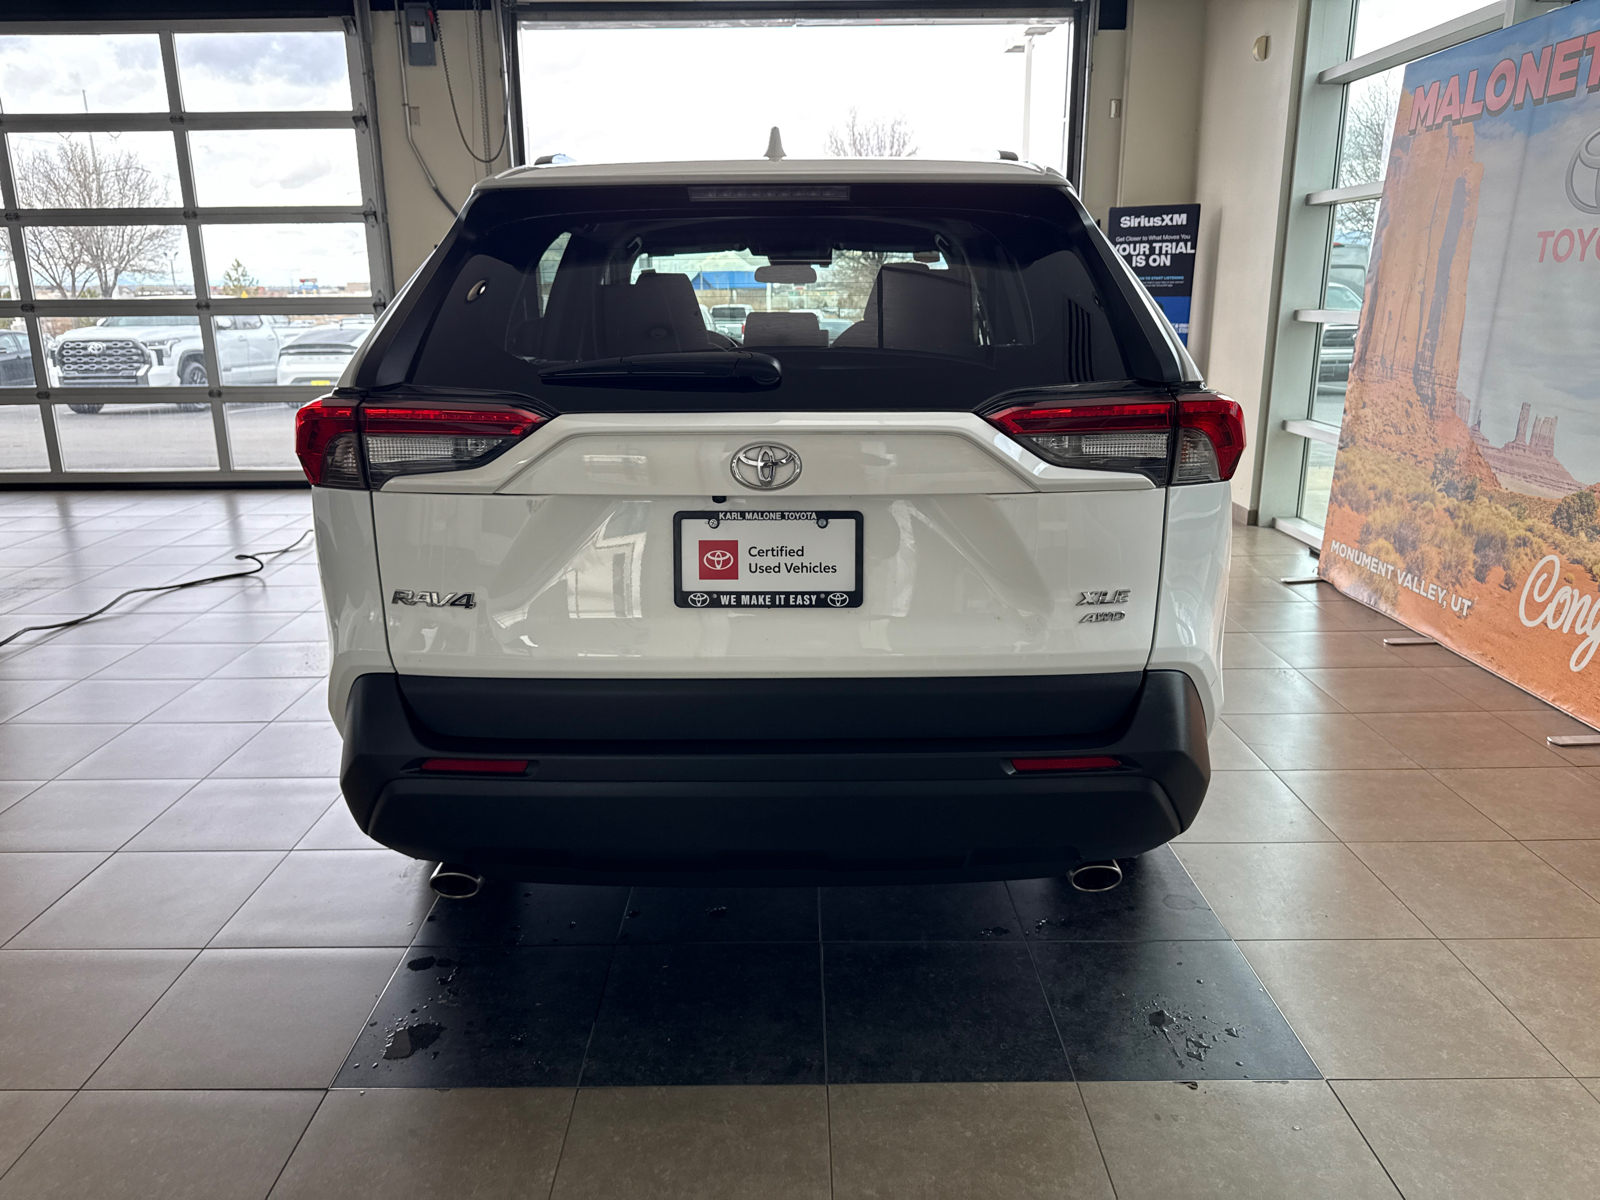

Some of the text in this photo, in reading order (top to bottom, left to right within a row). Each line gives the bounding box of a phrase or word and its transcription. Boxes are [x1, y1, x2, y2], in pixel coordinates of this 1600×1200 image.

[1120, 213, 1187, 228] SiriusXM
[1152, 241, 1195, 254] TRIAL
[1537, 227, 1600, 263] TOY
[1132, 254, 1171, 267] IS ON
[719, 512, 817, 520] KARL MALONE TOYOTA
[748, 546, 805, 557] Certified
[748, 562, 837, 574] Used Vehicles
[1330, 539, 1472, 616] MONUMENT VALLEY, UT
[391, 589, 476, 610] RAV4
[720, 594, 817, 605] WE MAKE IT EASY
[1075, 588, 1132, 606] XLE
[1078, 610, 1126, 624] AWD
